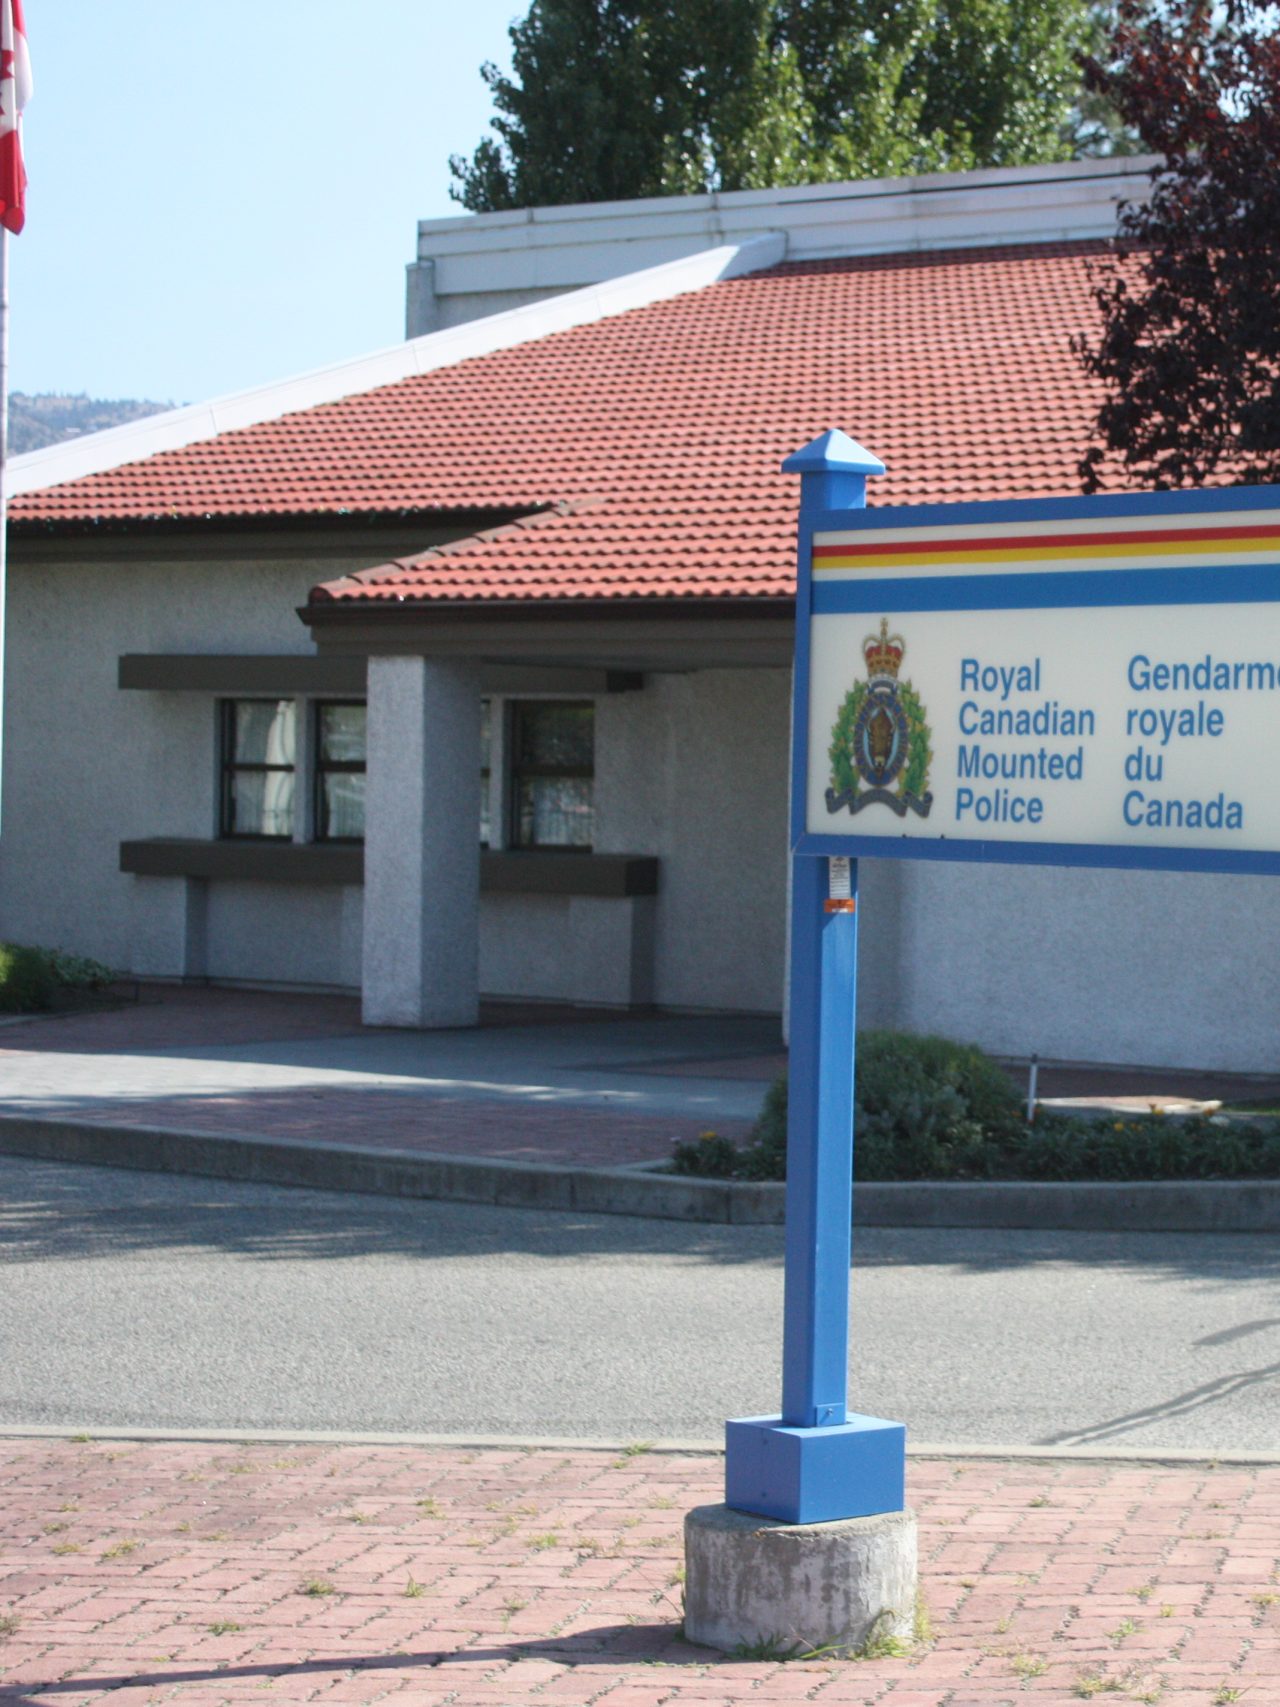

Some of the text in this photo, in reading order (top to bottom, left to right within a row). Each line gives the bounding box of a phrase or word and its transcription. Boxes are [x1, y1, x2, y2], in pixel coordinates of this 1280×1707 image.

[960, 658, 1040, 700] Royal
[959, 700, 1095, 736] Canadian
[1127, 701, 1225, 745] royale
[957, 745, 1083, 780] Mounted
[1125, 746, 1163, 781] du
[956, 787, 1044, 823] Police
[1123, 790, 1244, 830] Canada
